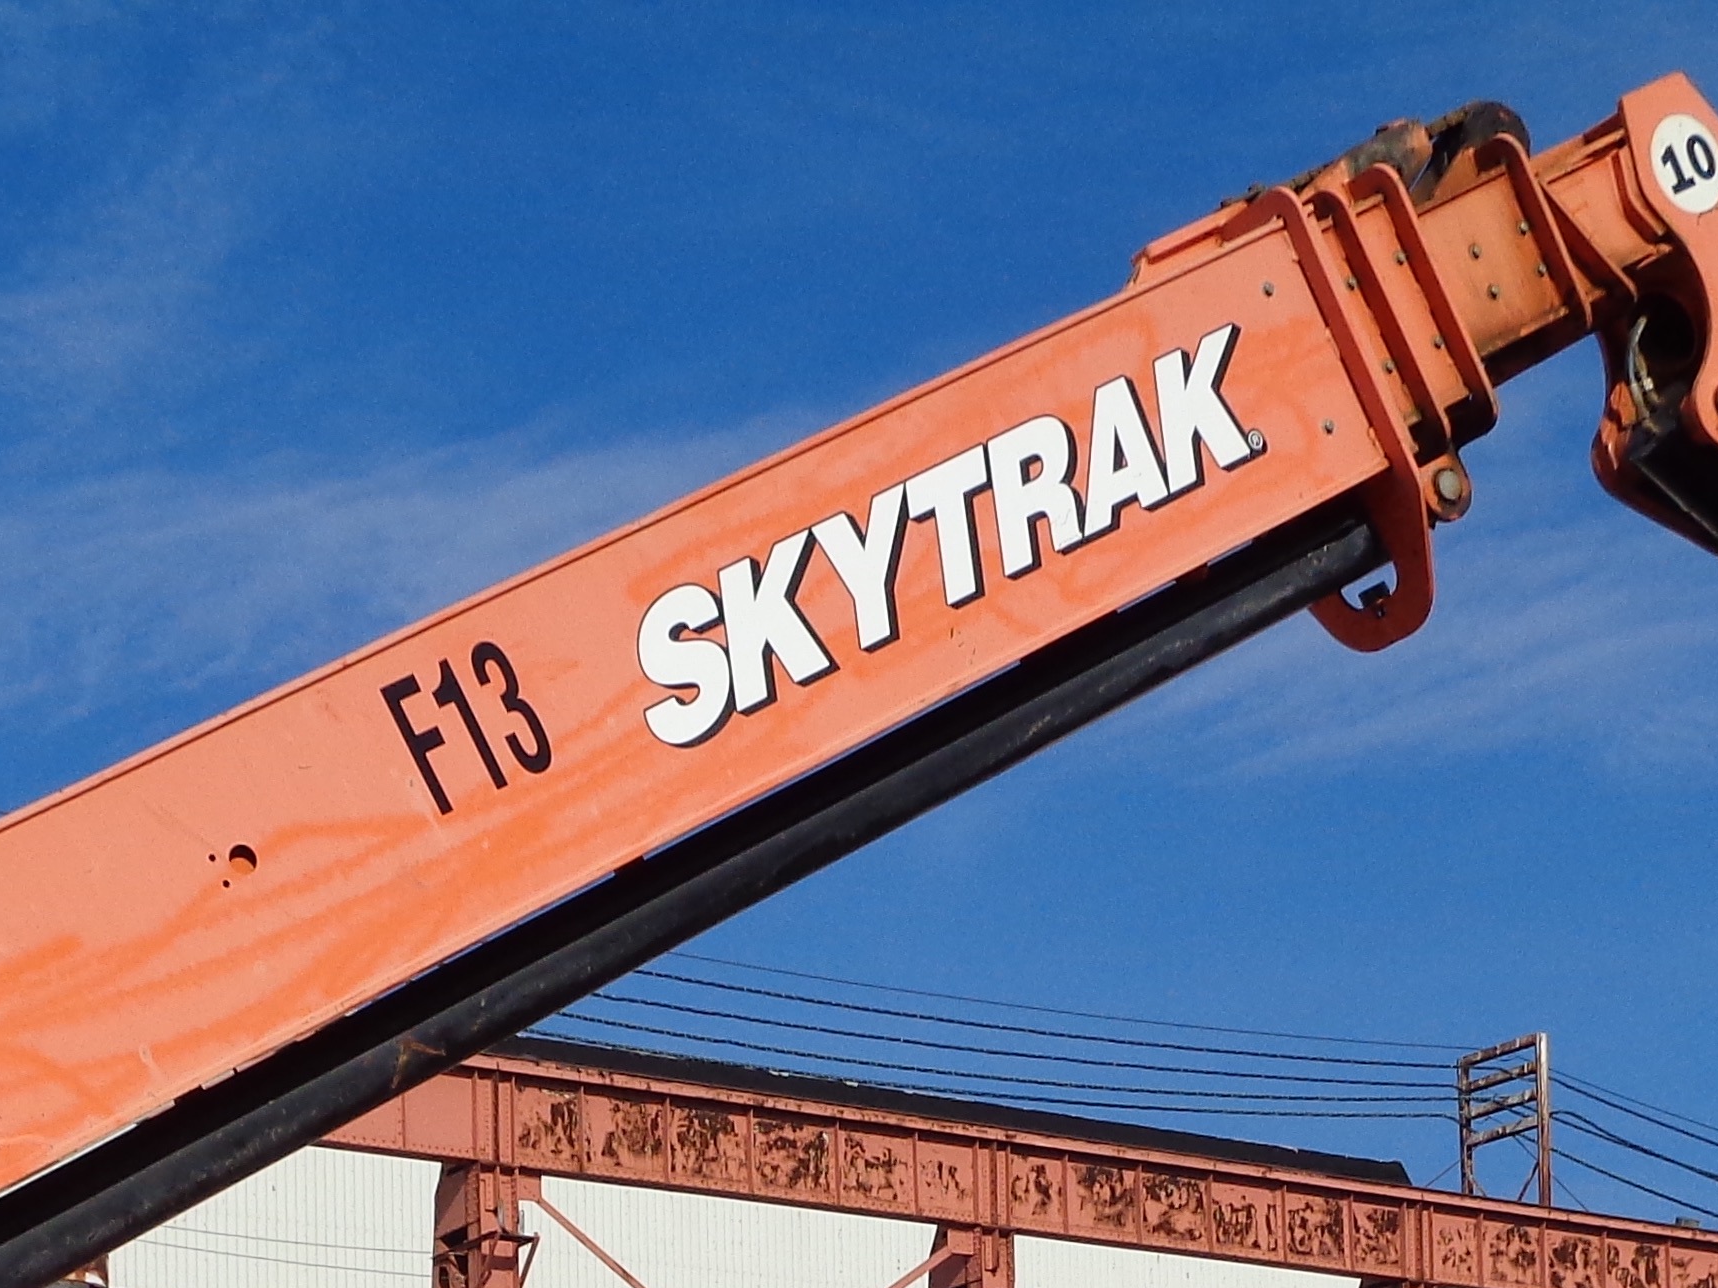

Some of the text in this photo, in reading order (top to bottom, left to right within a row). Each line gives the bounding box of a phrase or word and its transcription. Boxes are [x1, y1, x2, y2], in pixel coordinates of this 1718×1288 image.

[1661, 134, 1716, 194] 10
[636, 323, 1254, 747] SKYTRAK
[380, 640, 553, 816] F13
